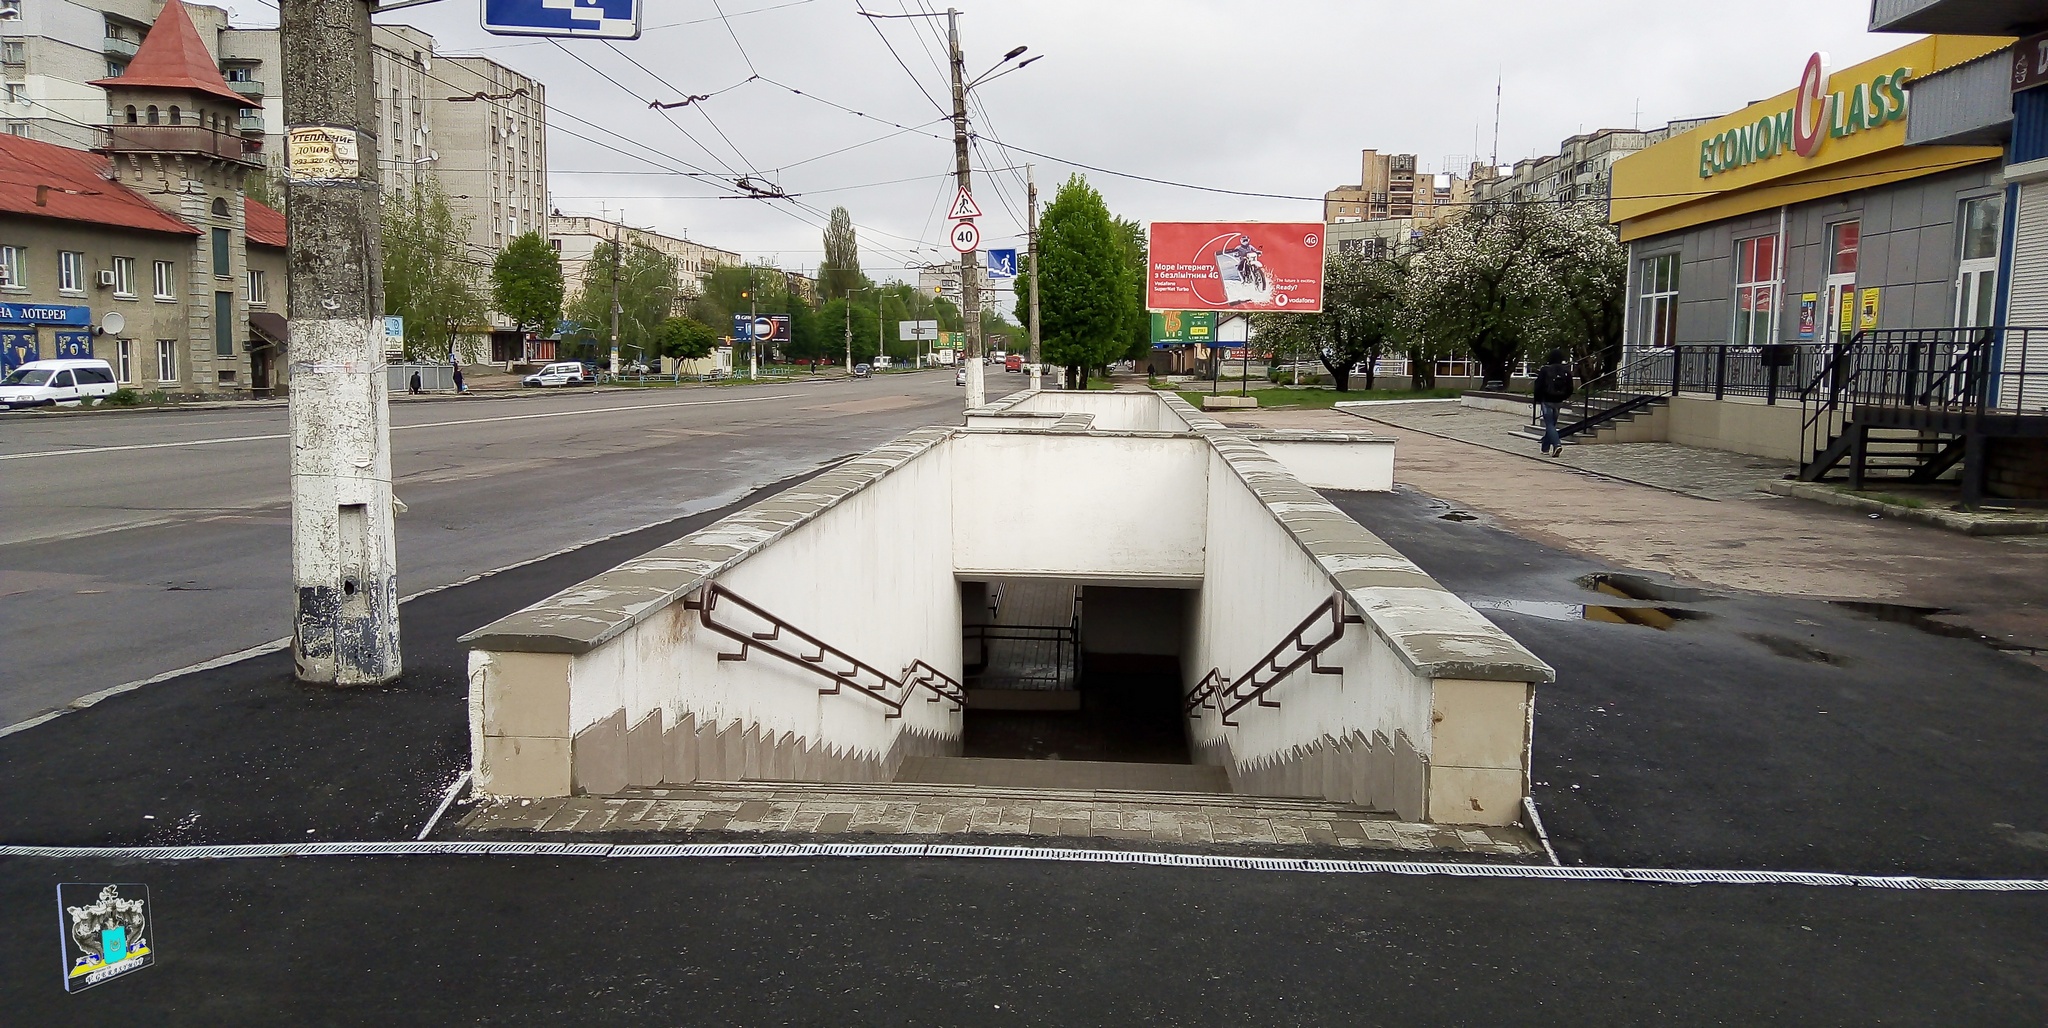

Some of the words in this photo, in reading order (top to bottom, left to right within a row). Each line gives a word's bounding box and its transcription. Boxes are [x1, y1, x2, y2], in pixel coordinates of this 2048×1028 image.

[957, 230, 973, 243] 40
[1154, 263, 1176, 272] Море
[20, 308, 66, 320] ЛОТЕРЕЯ
